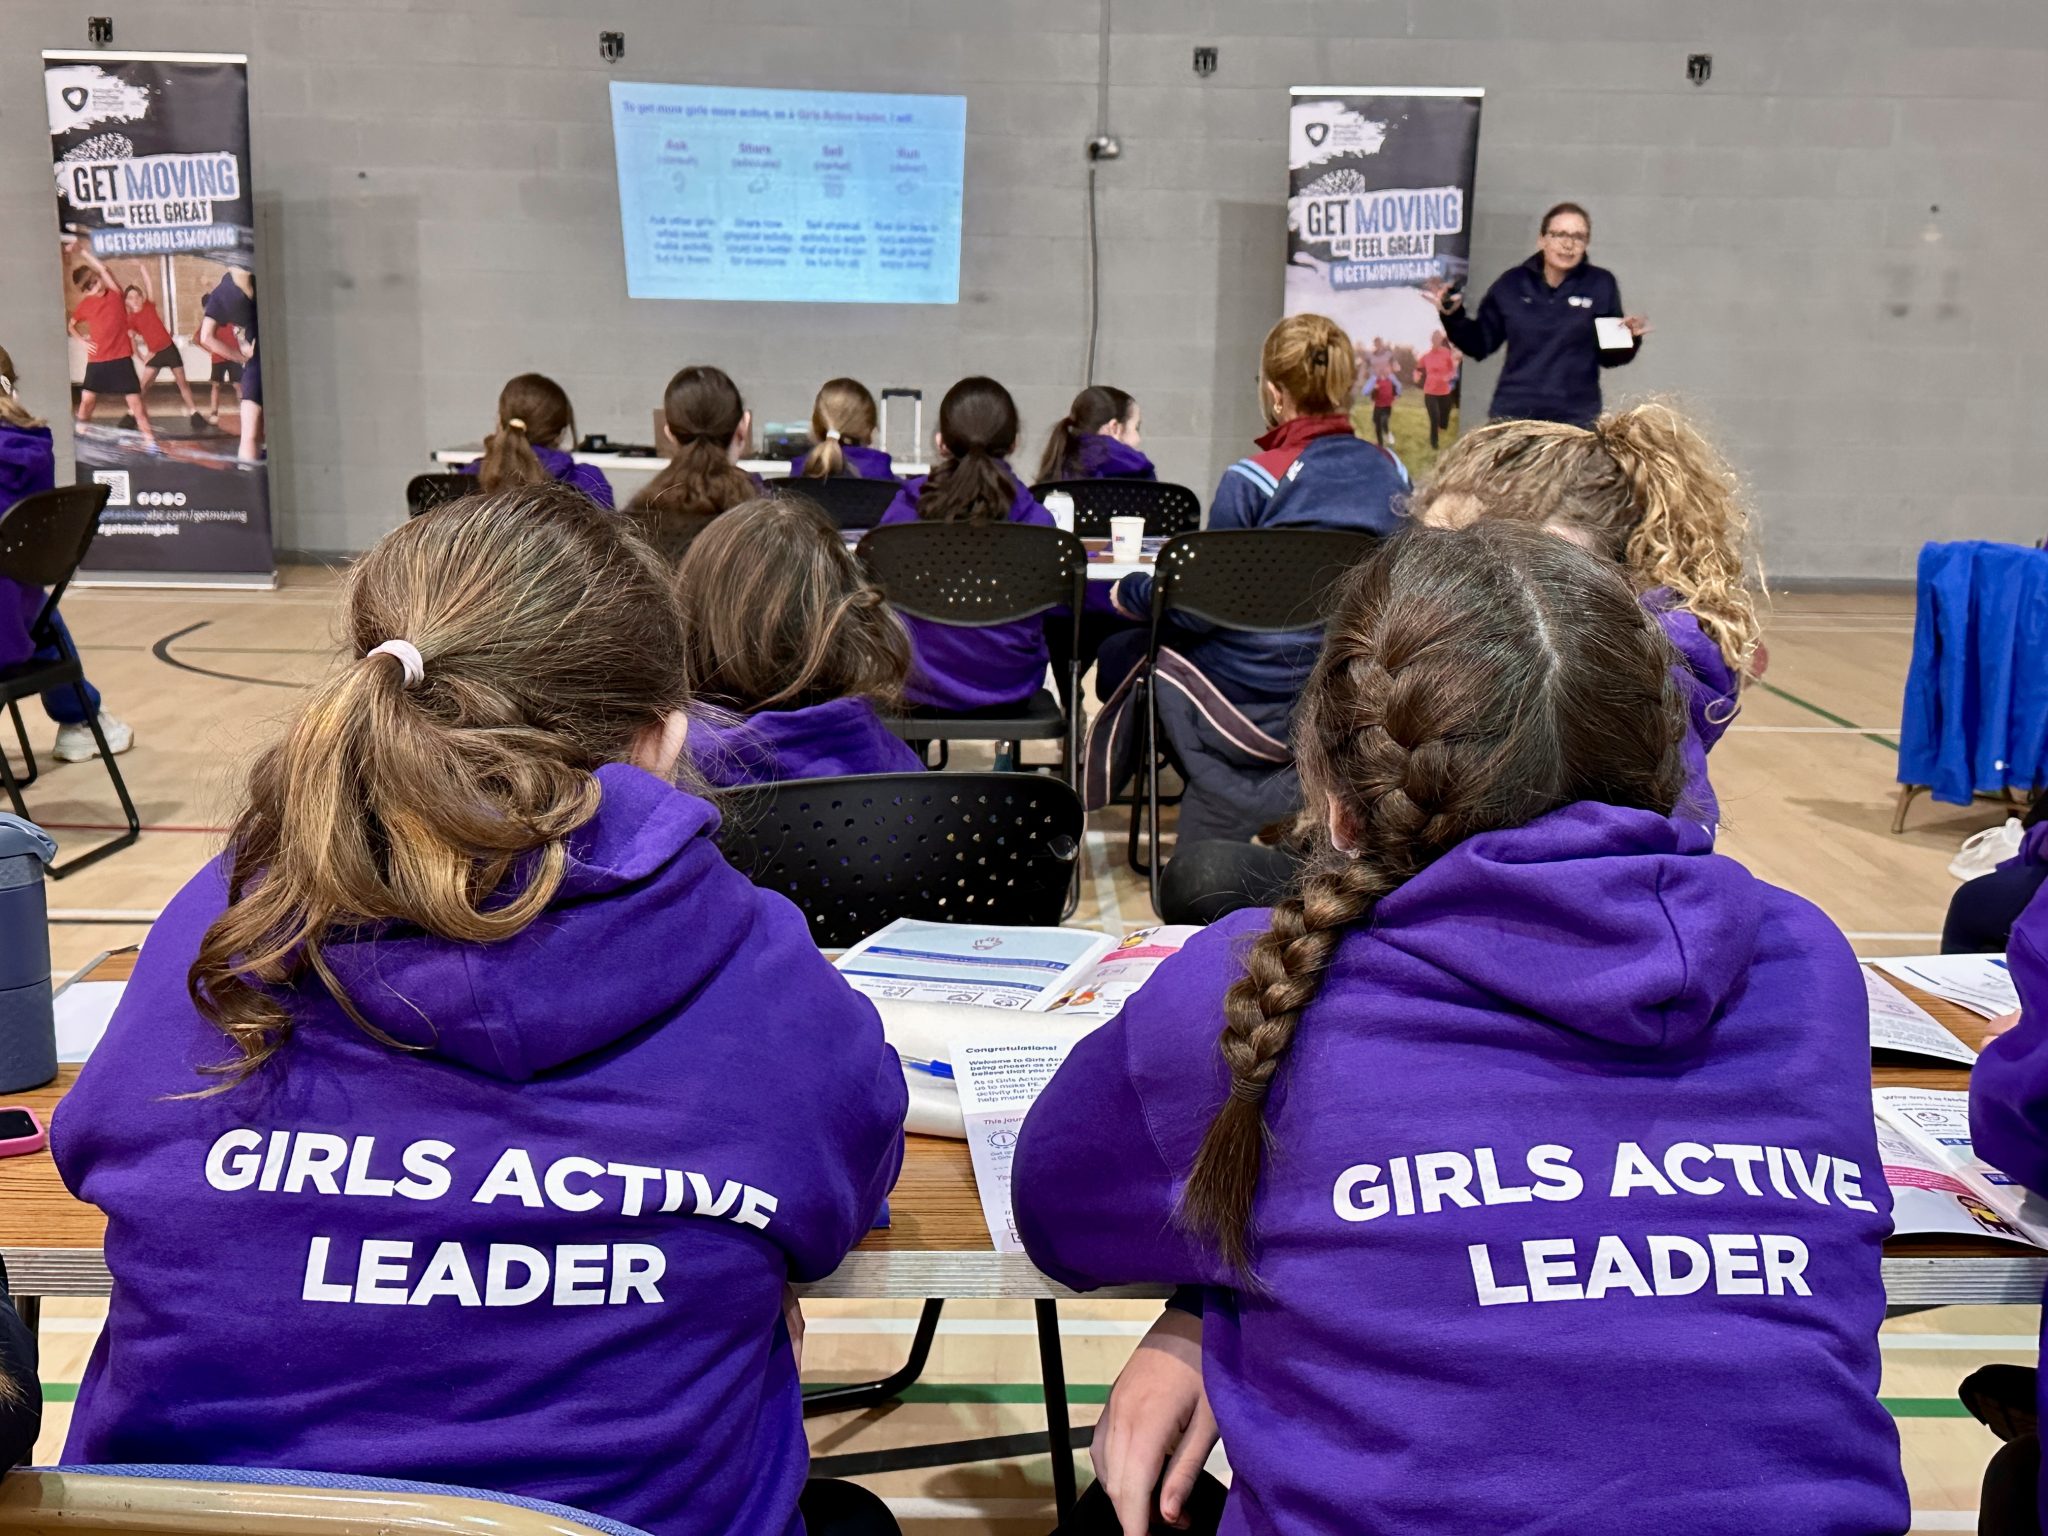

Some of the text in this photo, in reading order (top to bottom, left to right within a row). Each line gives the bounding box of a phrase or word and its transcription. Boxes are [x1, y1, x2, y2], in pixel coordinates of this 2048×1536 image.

[73, 158, 236, 202] GET MOVING
[130, 203, 162, 226] FEEL
[164, 201, 208, 224] GREAT
[1307, 194, 1458, 236] GET MOVING
[94, 227, 236, 251] #GETSCHOOLSMOVING
[1356, 238, 1384, 258] FEEL
[1388, 234, 1430, 256] GREAT
[966, 1045, 1057, 1054] Congratulations!
[970, 1064, 996, 1072] being
[205, 1128, 779, 1230] GIRLS ACTIVE
[1333, 1142, 1878, 1222] GIRLS ACTIVE
[302, 1236, 667, 1307] LEADER
[1467, 1233, 1813, 1306] LEADER
